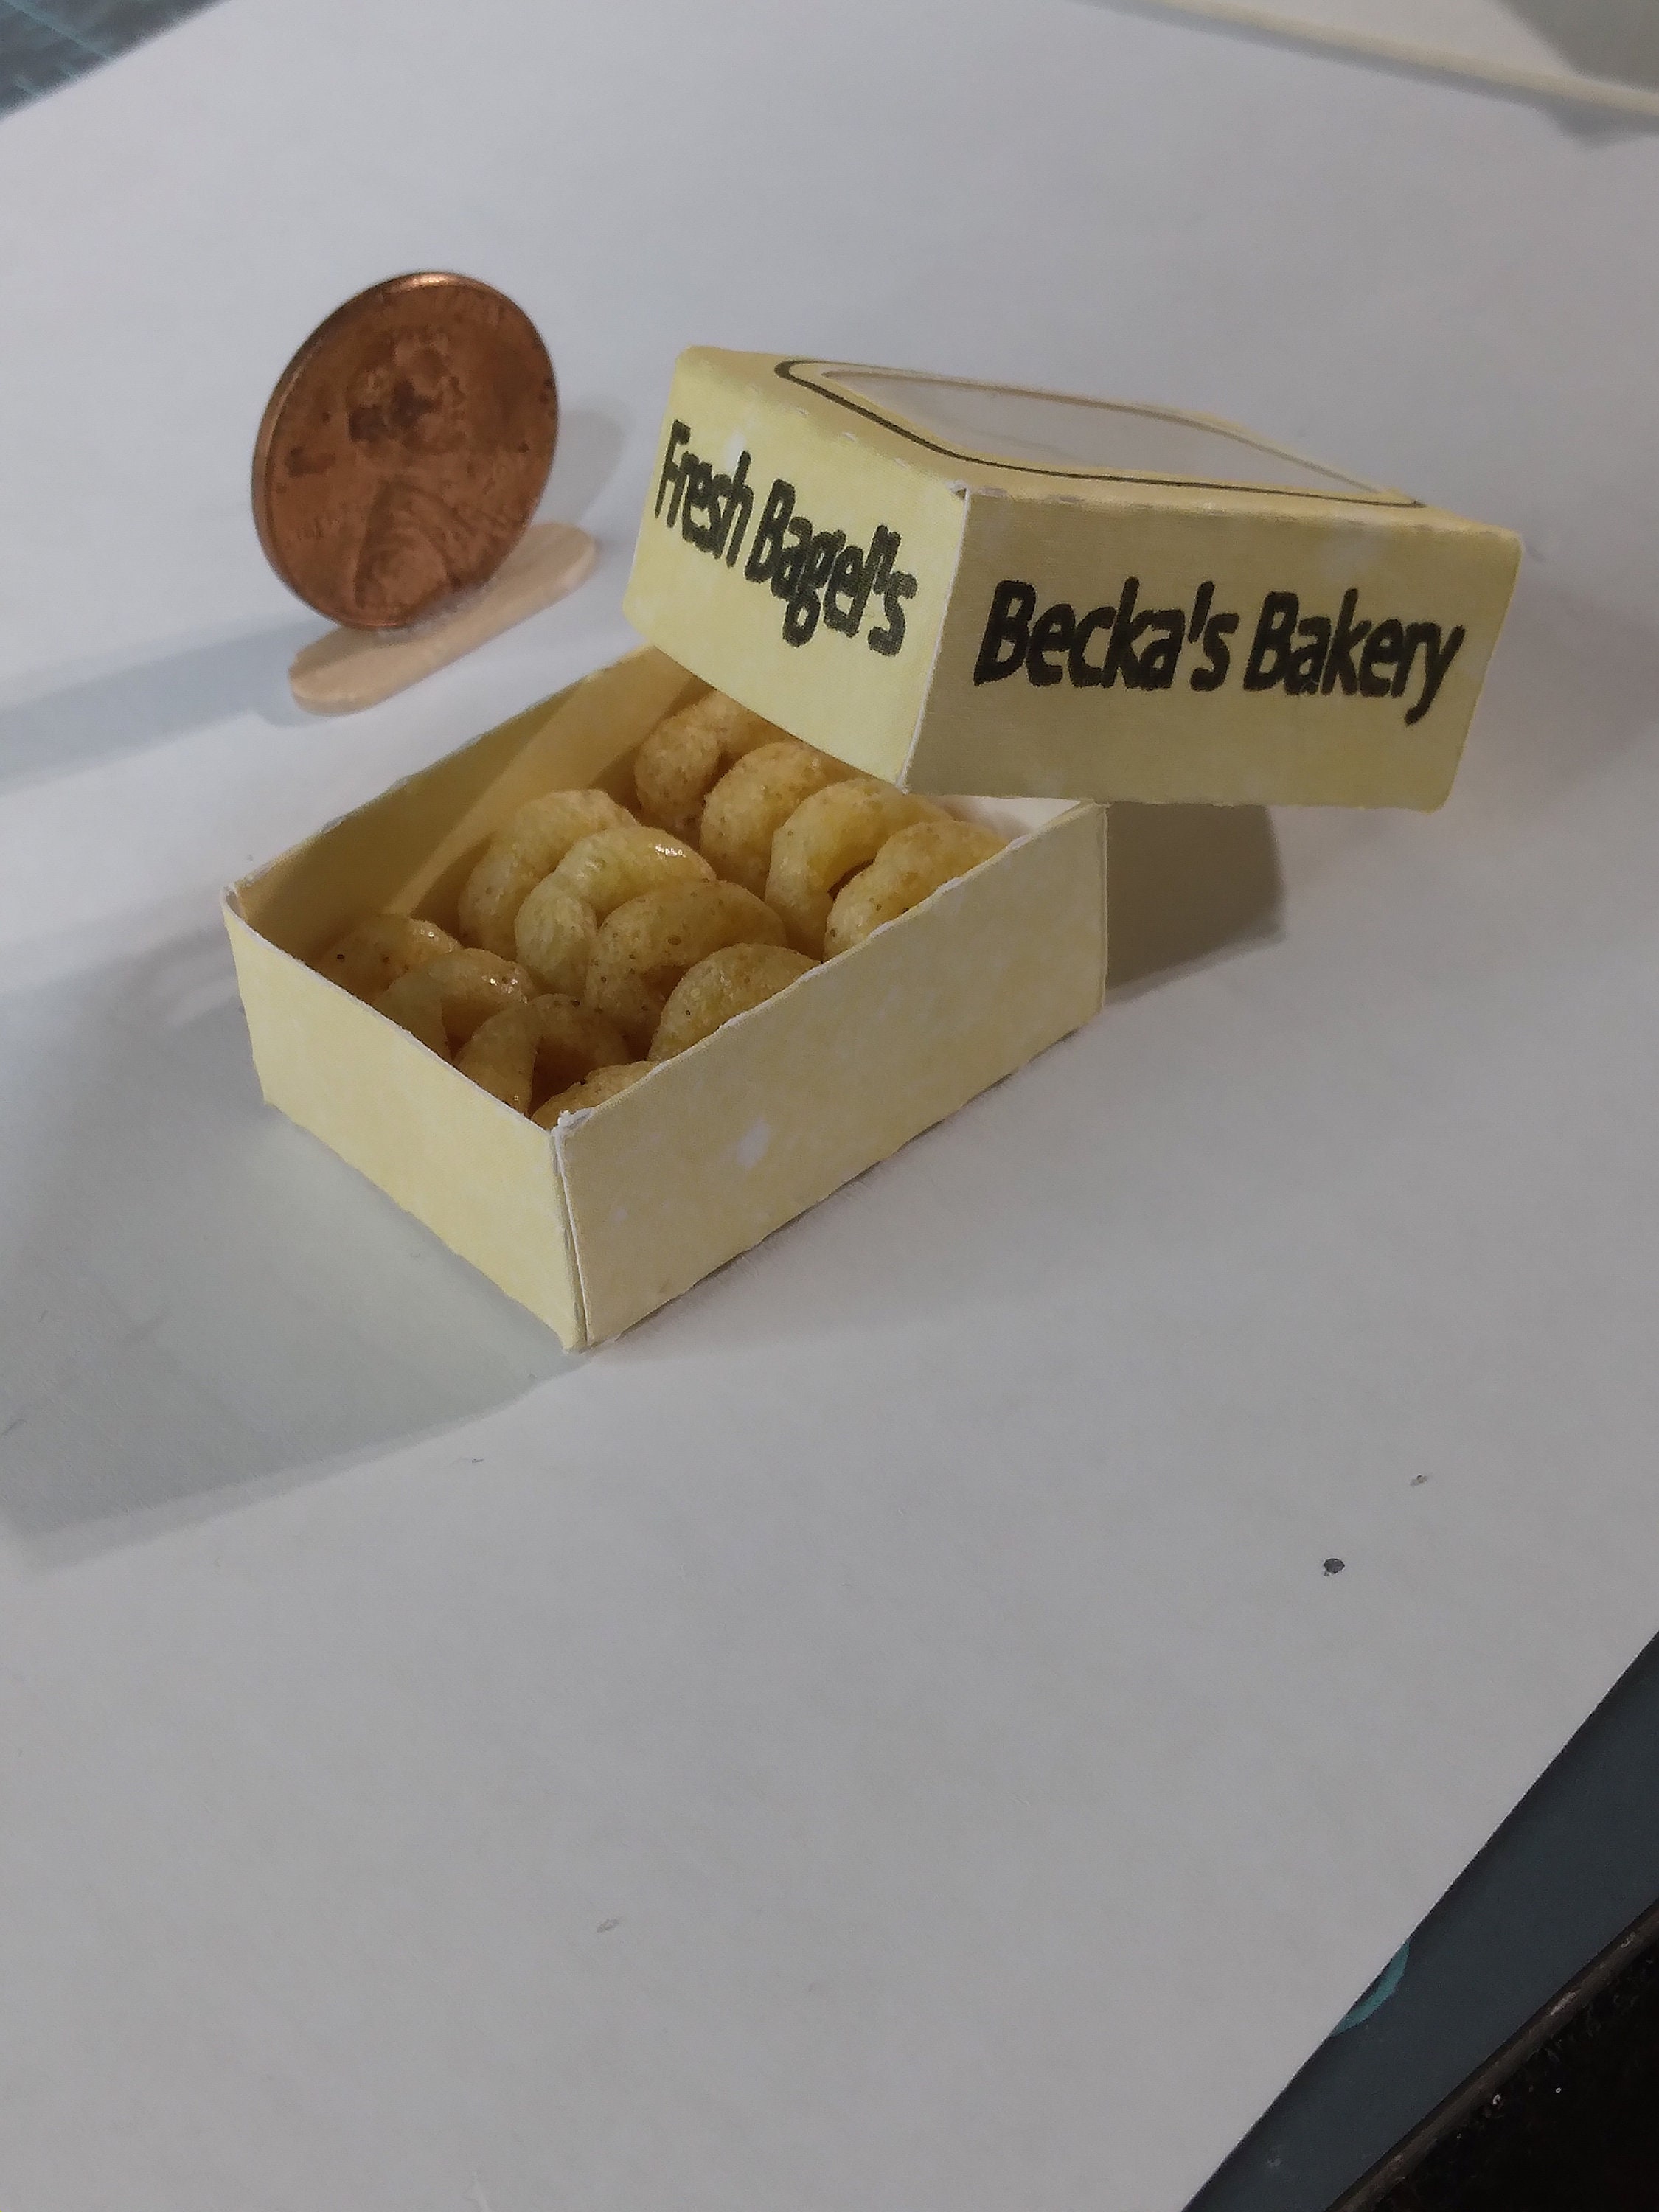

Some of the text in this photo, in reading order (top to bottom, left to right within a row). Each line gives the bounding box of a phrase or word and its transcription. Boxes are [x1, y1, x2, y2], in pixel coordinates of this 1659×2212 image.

[655, 419, 918, 656] Fresh Bagel's
[973, 576, 1467, 727] Becka's Bakery
